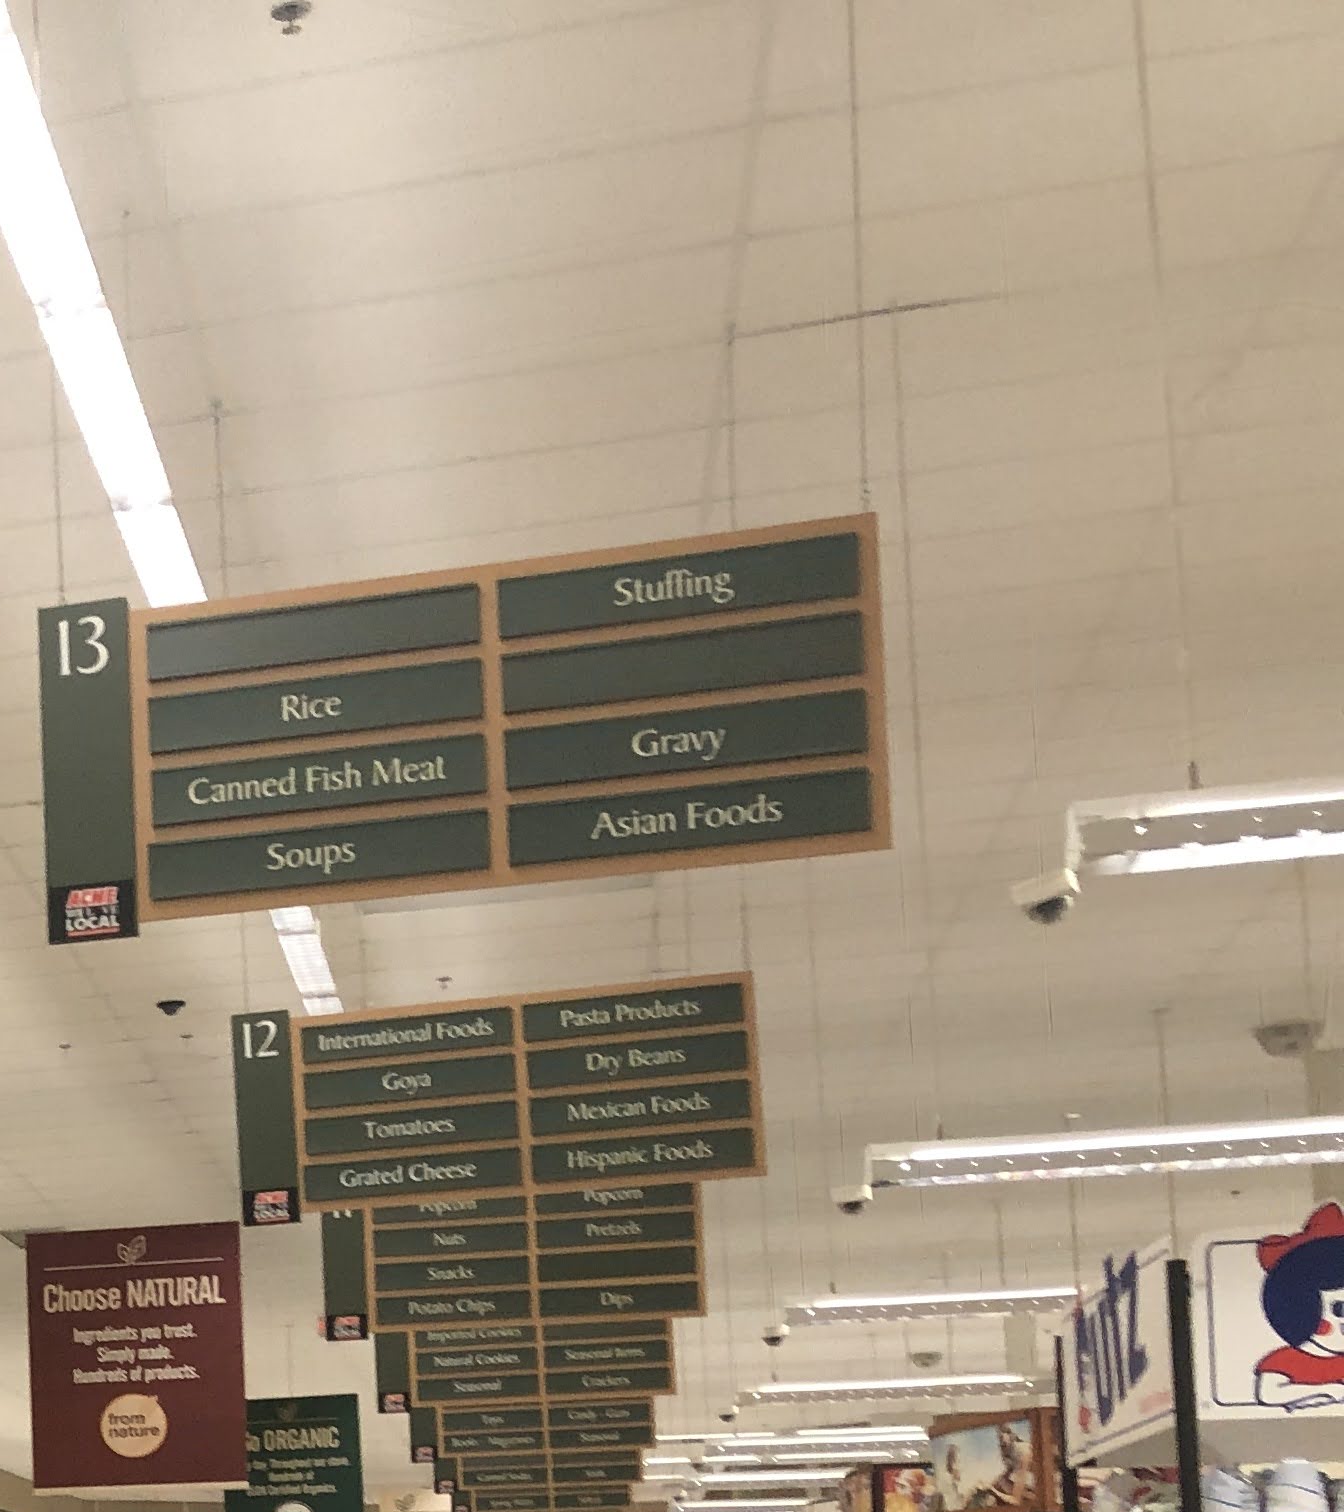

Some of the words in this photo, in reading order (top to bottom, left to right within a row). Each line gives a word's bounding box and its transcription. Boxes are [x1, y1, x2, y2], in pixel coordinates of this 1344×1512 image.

[613, 566, 735, 607] Stuffing
[56, 616, 110, 676] 13
[279, 690, 342, 722] Rice
[631, 725, 726, 761] Gravy
[188, 768, 300, 806] Canned
[307, 763, 363, 794] Fish
[370, 756, 446, 788] Meat
[591, 807, 675, 842] Asian
[685, 795, 783, 830] Foods
[267, 838, 356, 875] Soups
[65, 915, 121, 931] LOCAL
[559, 1004, 617, 1029] Pasta
[621, 998, 702, 1022] Products
[242, 1020, 280, 1059] 12
[318, 1022, 432, 1052] International
[436, 1016, 494, 1041] Foods
[585, 1051, 621, 1075] Dry
[627, 1045, 686, 1068] Beans
[381, 1070, 432, 1095] Goya
[567, 1099, 648, 1122] Mexican
[650, 1091, 711, 1116] Foods
[364, 1116, 456, 1140] Tomatoes
[567, 1145, 649, 1171] Hispanic
[653, 1139, 713, 1162] Foods
[339, 1163, 404, 1189] Grated
[408, 1157, 478, 1182] Cheese
[43, 1283, 121, 1313] Choose
[126, 1275, 227, 1308] NATURAL
[108, 1413, 146, 1425] from
[108, 1425, 160, 1438] nature
[263, 1425, 340, 1452] ORGANIC
